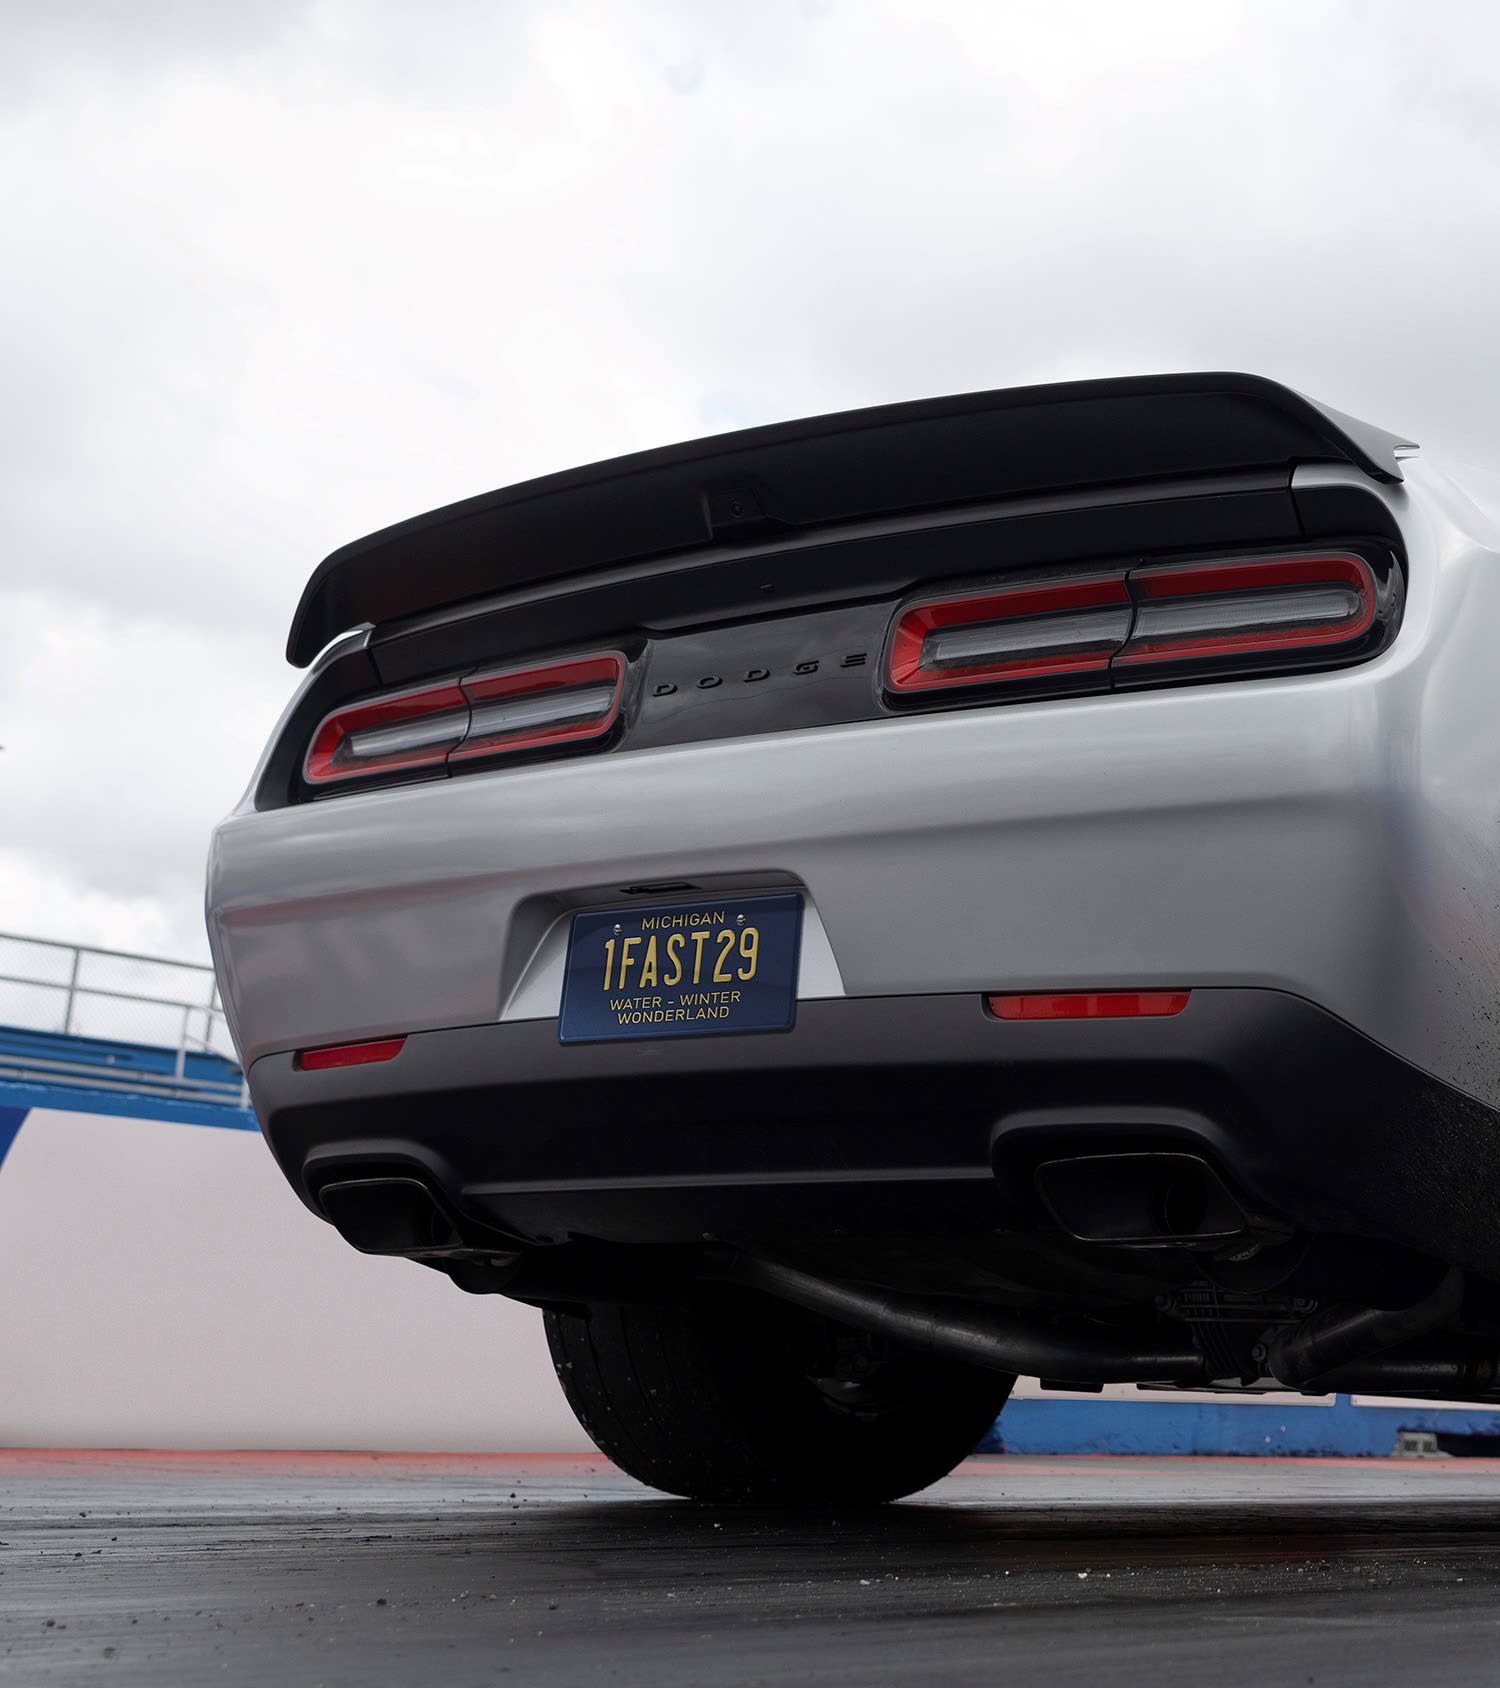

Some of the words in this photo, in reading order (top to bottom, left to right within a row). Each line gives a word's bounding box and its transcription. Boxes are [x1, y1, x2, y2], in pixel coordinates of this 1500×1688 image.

[652, 653, 867, 697] DODGE
[641, 911, 725, 930] MICHIGAN
[603, 927, 759, 991] 1FAST29
[610, 996, 662, 1011] WATER
[679, 991, 741, 1006] WINTER
[617, 1006, 730, 1025] WONDERLAND
